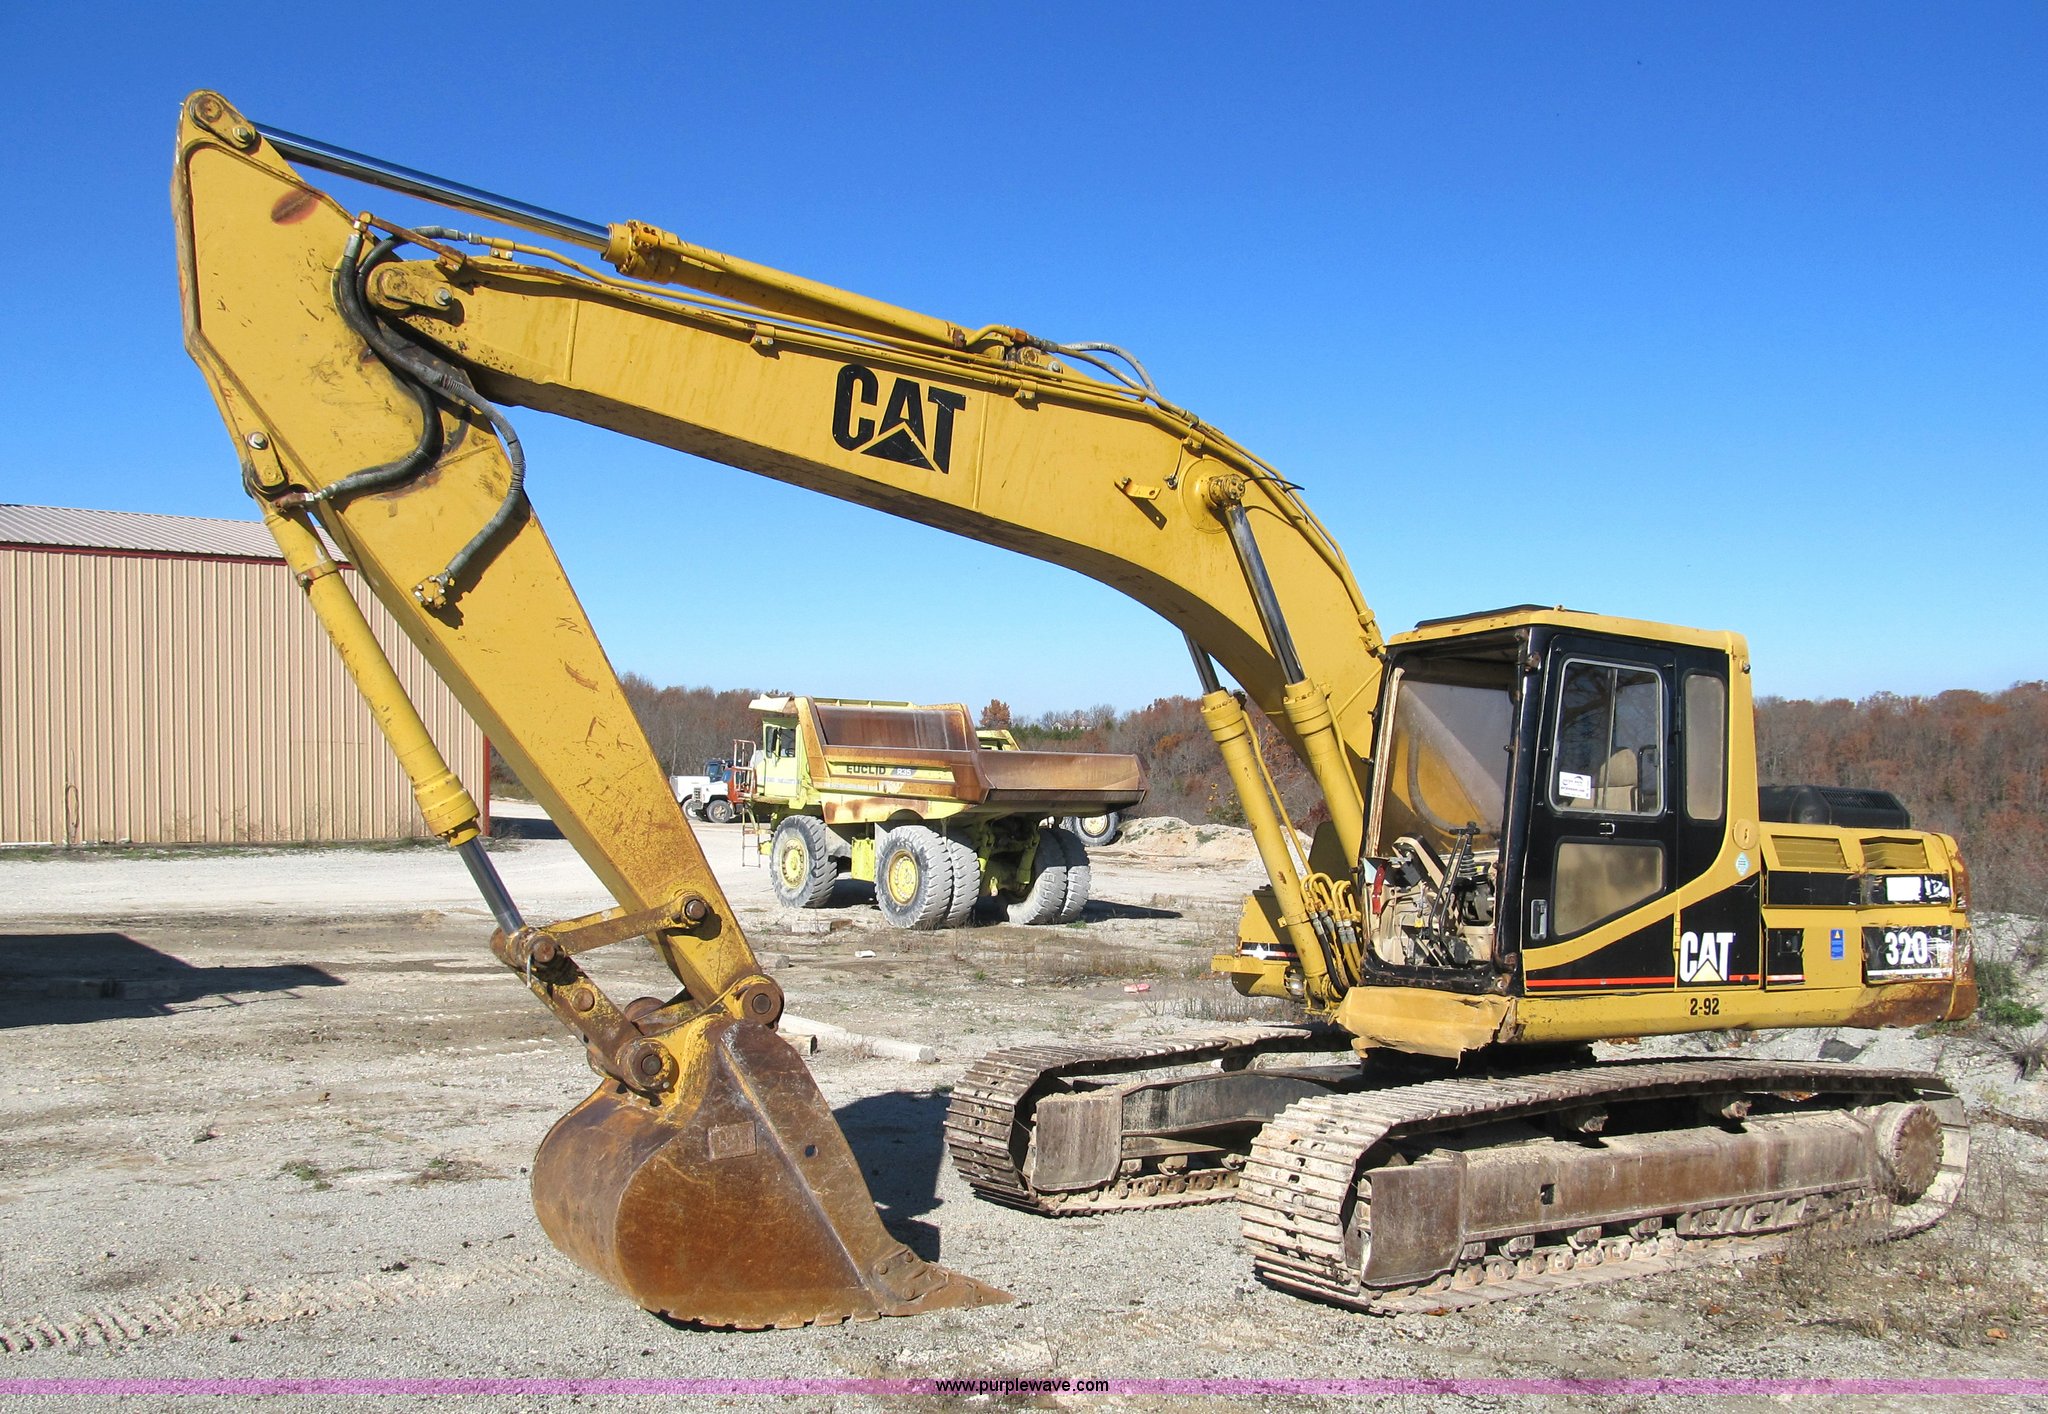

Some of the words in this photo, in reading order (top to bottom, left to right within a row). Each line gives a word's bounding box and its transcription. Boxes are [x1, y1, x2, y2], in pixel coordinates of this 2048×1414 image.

[832, 364, 966, 474] CAT
[846, 764, 886, 775] EUCLID
[1680, 931, 1734, 982] CAT
[1884, 931, 1928, 966] 320
[1690, 997, 1719, 1015] 2-92
